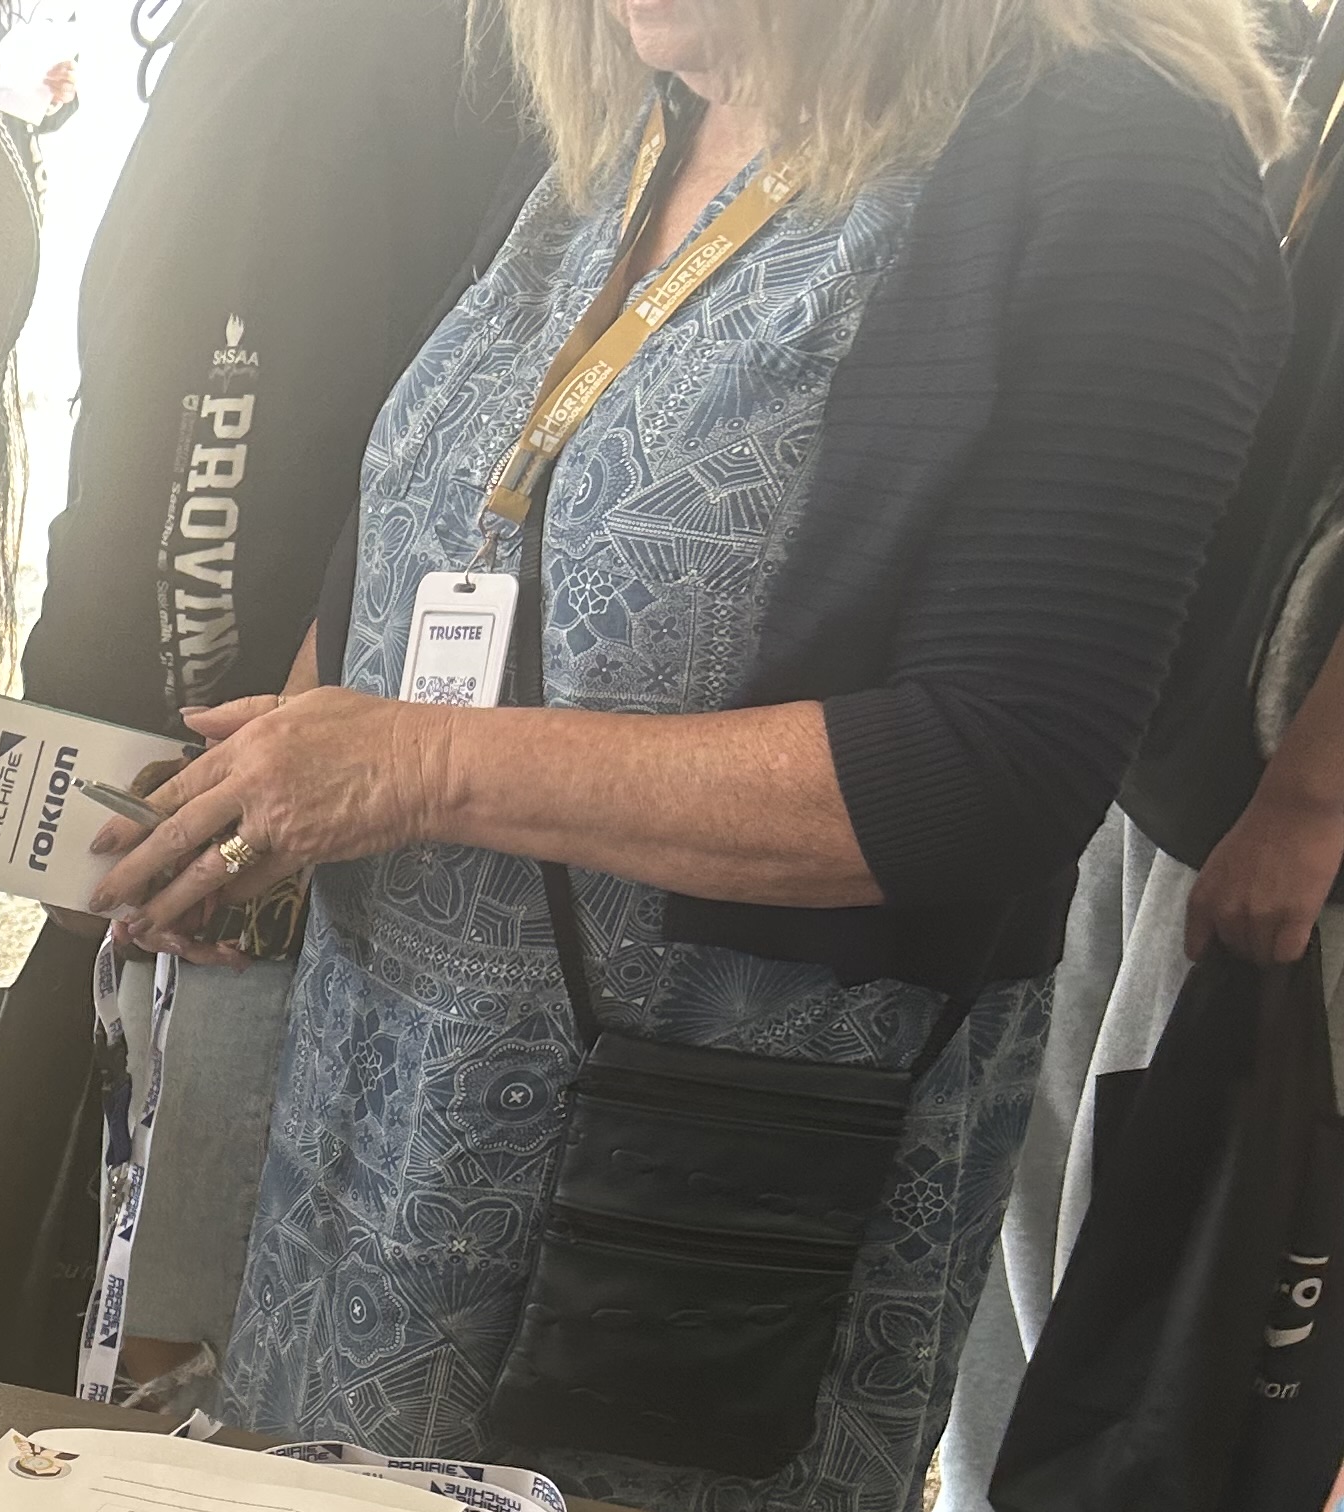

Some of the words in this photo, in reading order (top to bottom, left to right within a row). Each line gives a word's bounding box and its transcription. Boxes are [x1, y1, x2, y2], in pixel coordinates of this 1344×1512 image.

[650, 234, 729, 310] HORIZON
[662, 270, 699, 312] SCHOOL
[695, 240, 734, 281] DIVISION
[212, 347, 260, 367] SHSAA
[538, 360, 609, 442] HORIZON
[557, 403, 585, 444] SCHOOL
[580, 366, 614, 409] DIVISION
[429, 625, 483, 641] TRUSTEE
[28, 746, 79, 872] rokion
[387, 1460, 459, 1475] PRAIRIE
[444, 1482, 521, 1511] MACHINE
